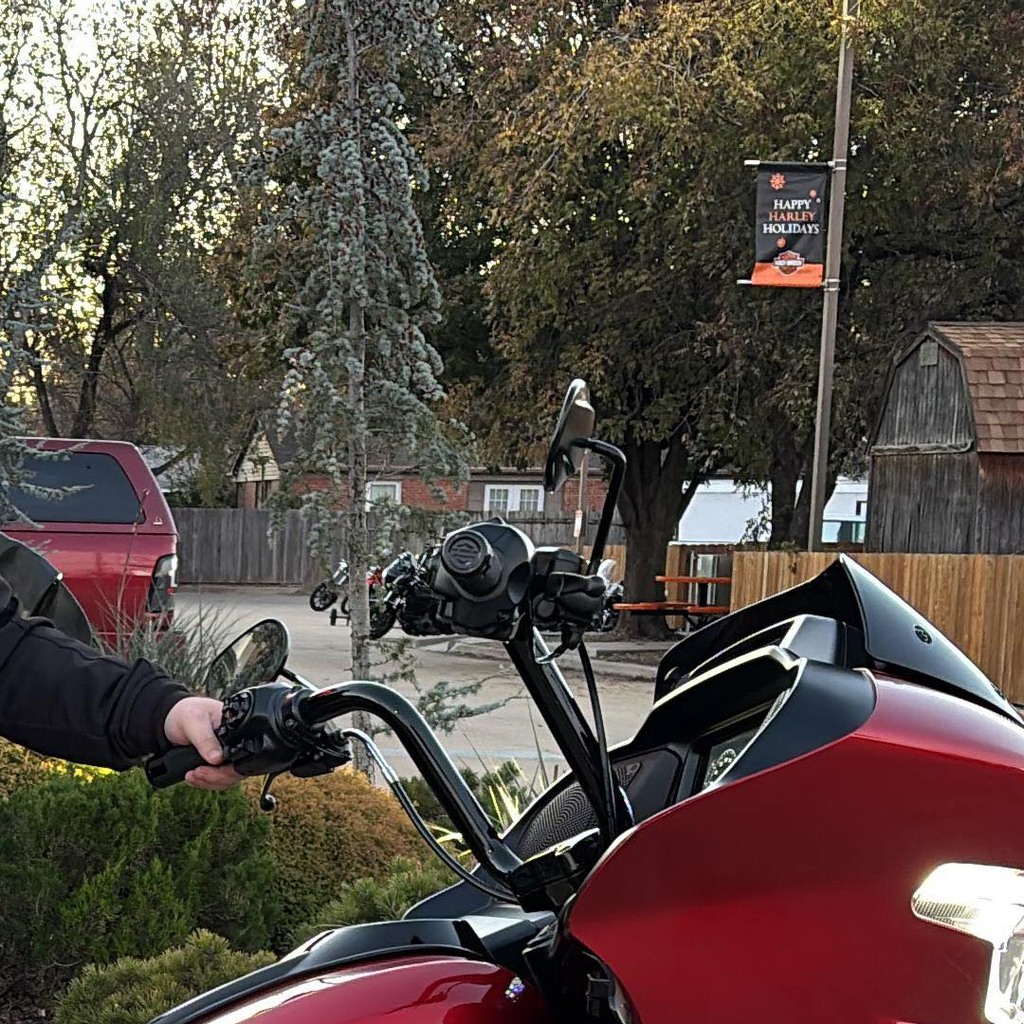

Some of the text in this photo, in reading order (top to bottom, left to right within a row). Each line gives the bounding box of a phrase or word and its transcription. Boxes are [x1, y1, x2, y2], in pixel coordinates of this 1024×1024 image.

[773, 199, 812, 210] HAPPY
[769, 211, 817, 221] HARLEY
[762, 223, 820, 234] HOLIDAYS
